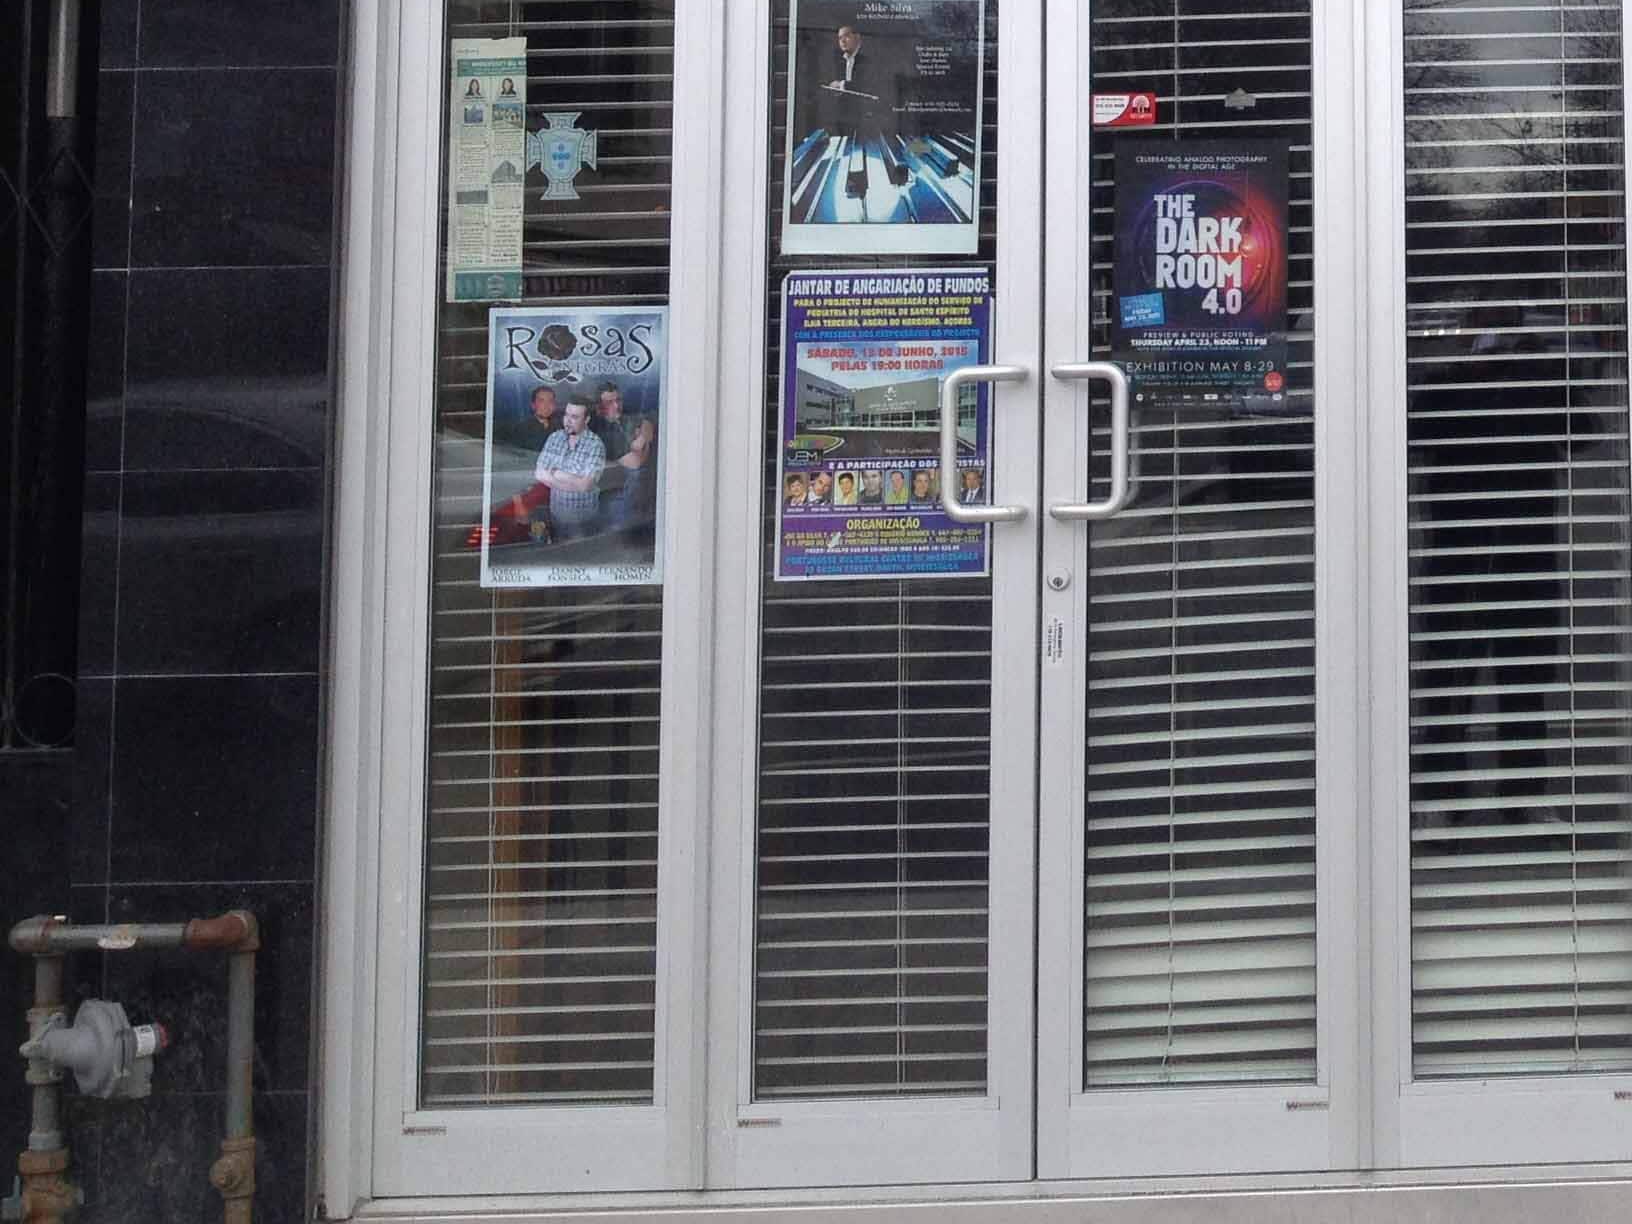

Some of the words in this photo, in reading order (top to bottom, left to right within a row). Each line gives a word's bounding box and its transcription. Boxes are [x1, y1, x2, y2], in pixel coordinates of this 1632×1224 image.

[865, 2, 889, 12] Mike
[1154, 194, 1195, 217] THE
[1156, 217, 1242, 253] DARK
[1156, 254, 1241, 288] ROOM
[789, 279, 832, 296] JANTAR
[835, 279, 849, 295] DE
[852, 275, 925, 296] ANGARIAÇÃO
[928, 278, 942, 294] DE
[944, 277, 989, 294] FUNDOS
[1201, 288, 1242, 314] 4.0
[1131, 339, 1173, 347] THURSDAY
[832, 359, 867, 371] PELAS
[1126, 362, 1204, 372] EXHIBITION
[1210, 362, 1238, 372] MAY
[1244, 361, 1274, 371] 8-29
[846, 516, 920, 530] ORGANIZAÇÃO
